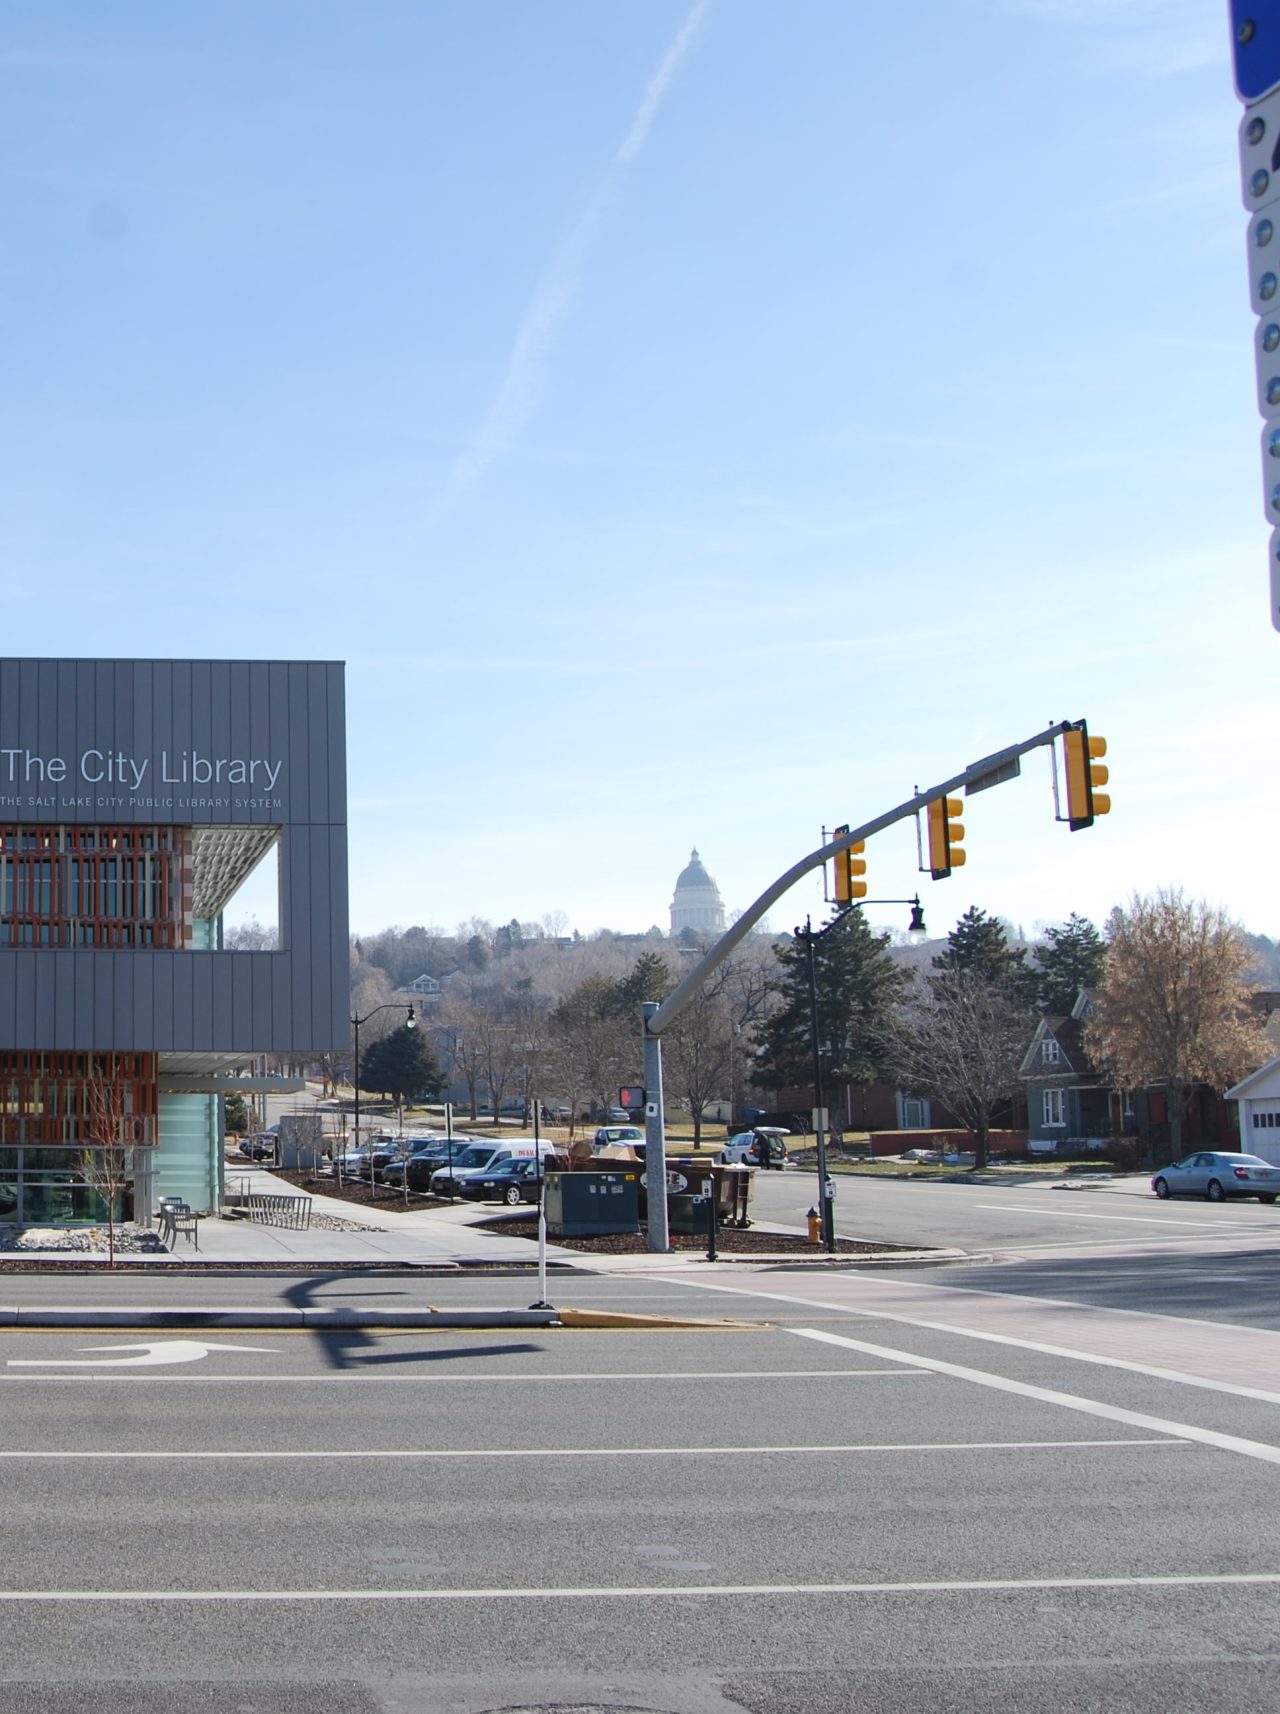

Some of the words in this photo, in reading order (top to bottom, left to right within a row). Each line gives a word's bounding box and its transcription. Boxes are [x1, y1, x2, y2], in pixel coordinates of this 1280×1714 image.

[0, 749, 67, 782] The
[80, 749, 149, 791] City
[161, 750, 283, 792] Library
[0, 796, 22, 807] THE
[28, 796, 56, 807] SALT
[62, 797, 92, 808] LAKE
[97, 797, 124, 808] CITY
[129, 797, 173, 808] PUBLIC
[179, 798, 231, 809] LIBRARY
[235, 799, 282, 809] SYSTEM
